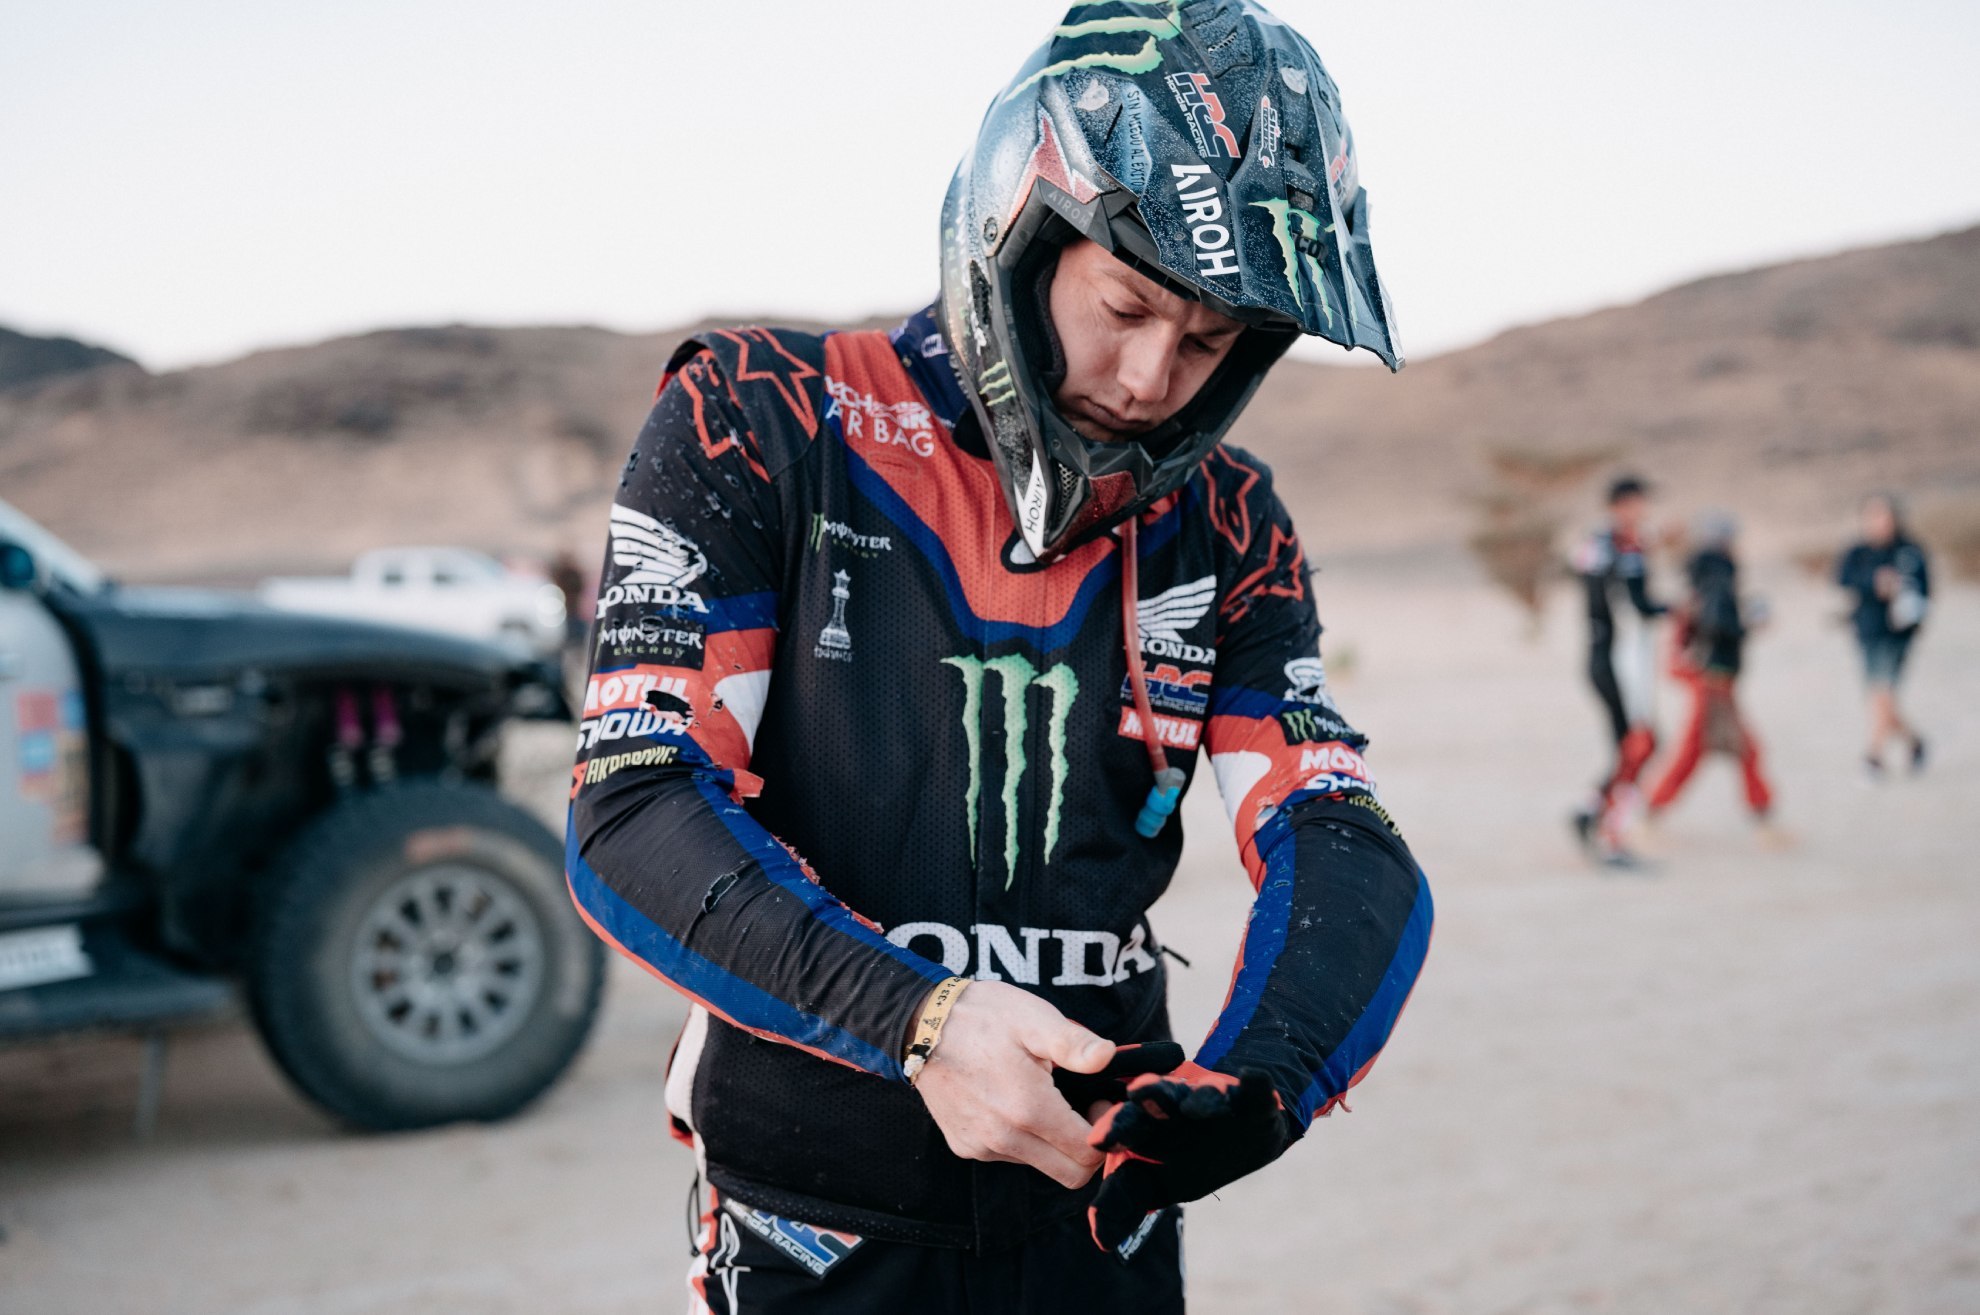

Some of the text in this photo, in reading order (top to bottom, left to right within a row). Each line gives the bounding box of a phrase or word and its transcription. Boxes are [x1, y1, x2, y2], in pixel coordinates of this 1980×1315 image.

[1127, 90, 1141, 111] SIN
[1164, 75, 1208, 158] Honda RACING
[1172, 72, 1241, 158] HRC
[1130, 148, 1145, 160] AL
[1046, 191, 1091, 230] AIROH
[1171, 164, 1240, 277] AIROH
[1025, 475, 1044, 534] AIROH
[613, 646, 685, 657] ENERGY
[1123, 711, 1198, 746] MTUL
[874, 921, 1156, 987] ONDA
[936, 989, 950, 1007] +33
[727, 1198, 770, 1237] Honda
[769, 1230, 826, 1275] RACING
